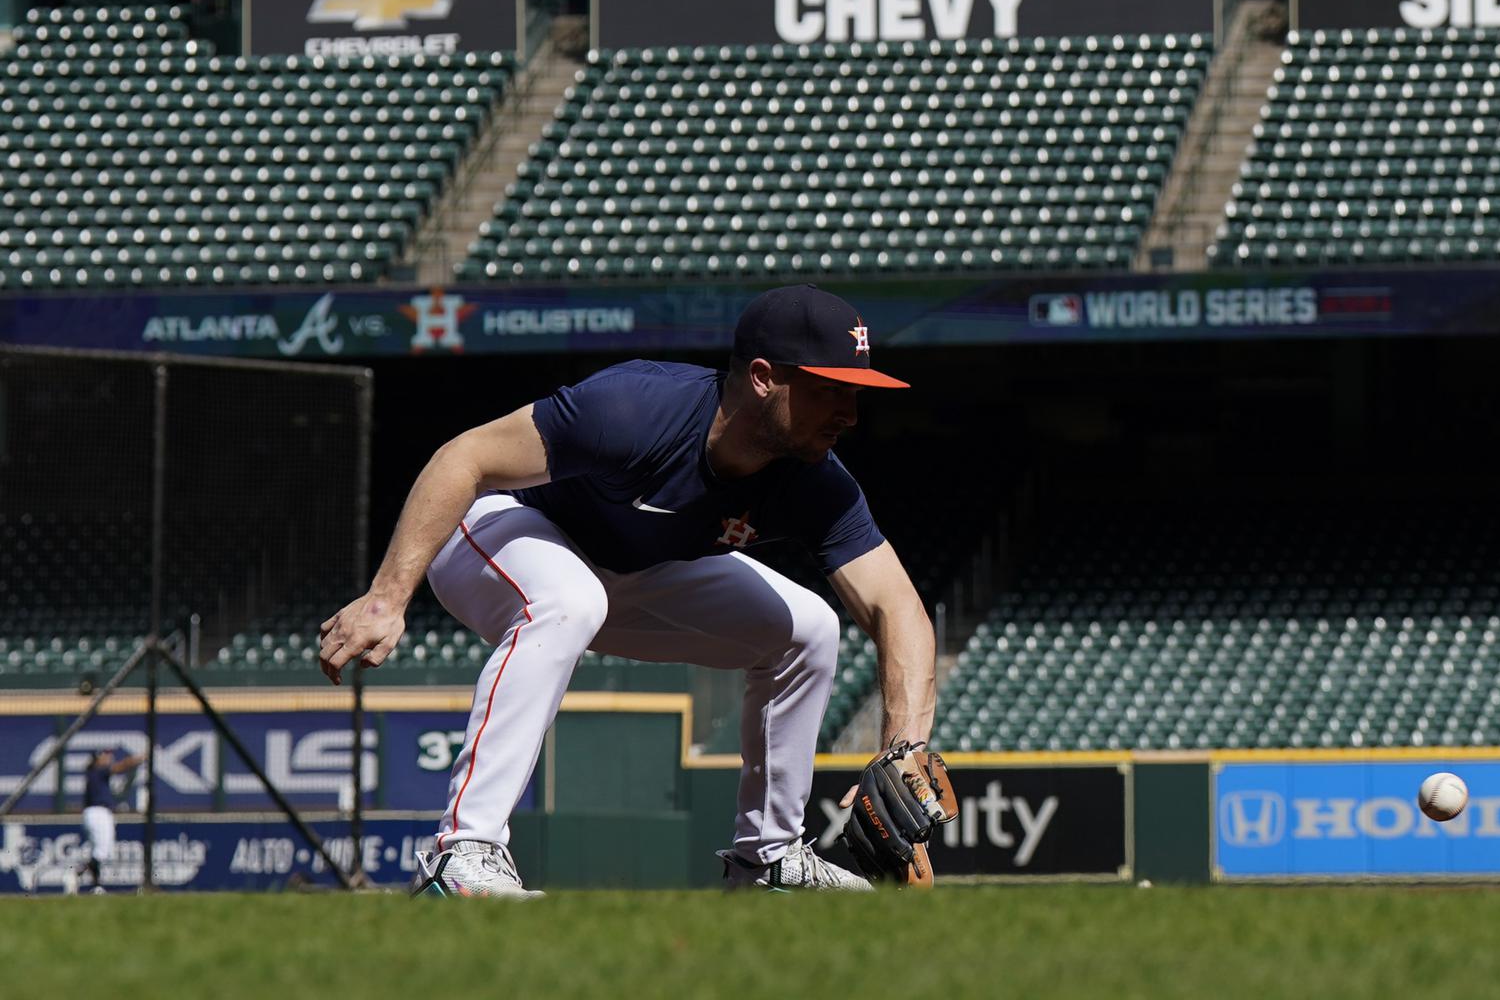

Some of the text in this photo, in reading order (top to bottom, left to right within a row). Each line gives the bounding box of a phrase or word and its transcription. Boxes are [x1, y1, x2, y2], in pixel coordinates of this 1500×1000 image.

[142, 313, 280, 342] ATLANTA
[483, 308, 634, 335] HOUSTON
[1084, 290, 1199, 327] WORLD
[1205, 287, 1317, 325] SERIES
[818, 780, 1059, 867] xity
[229, 837, 295, 874] AUTO
